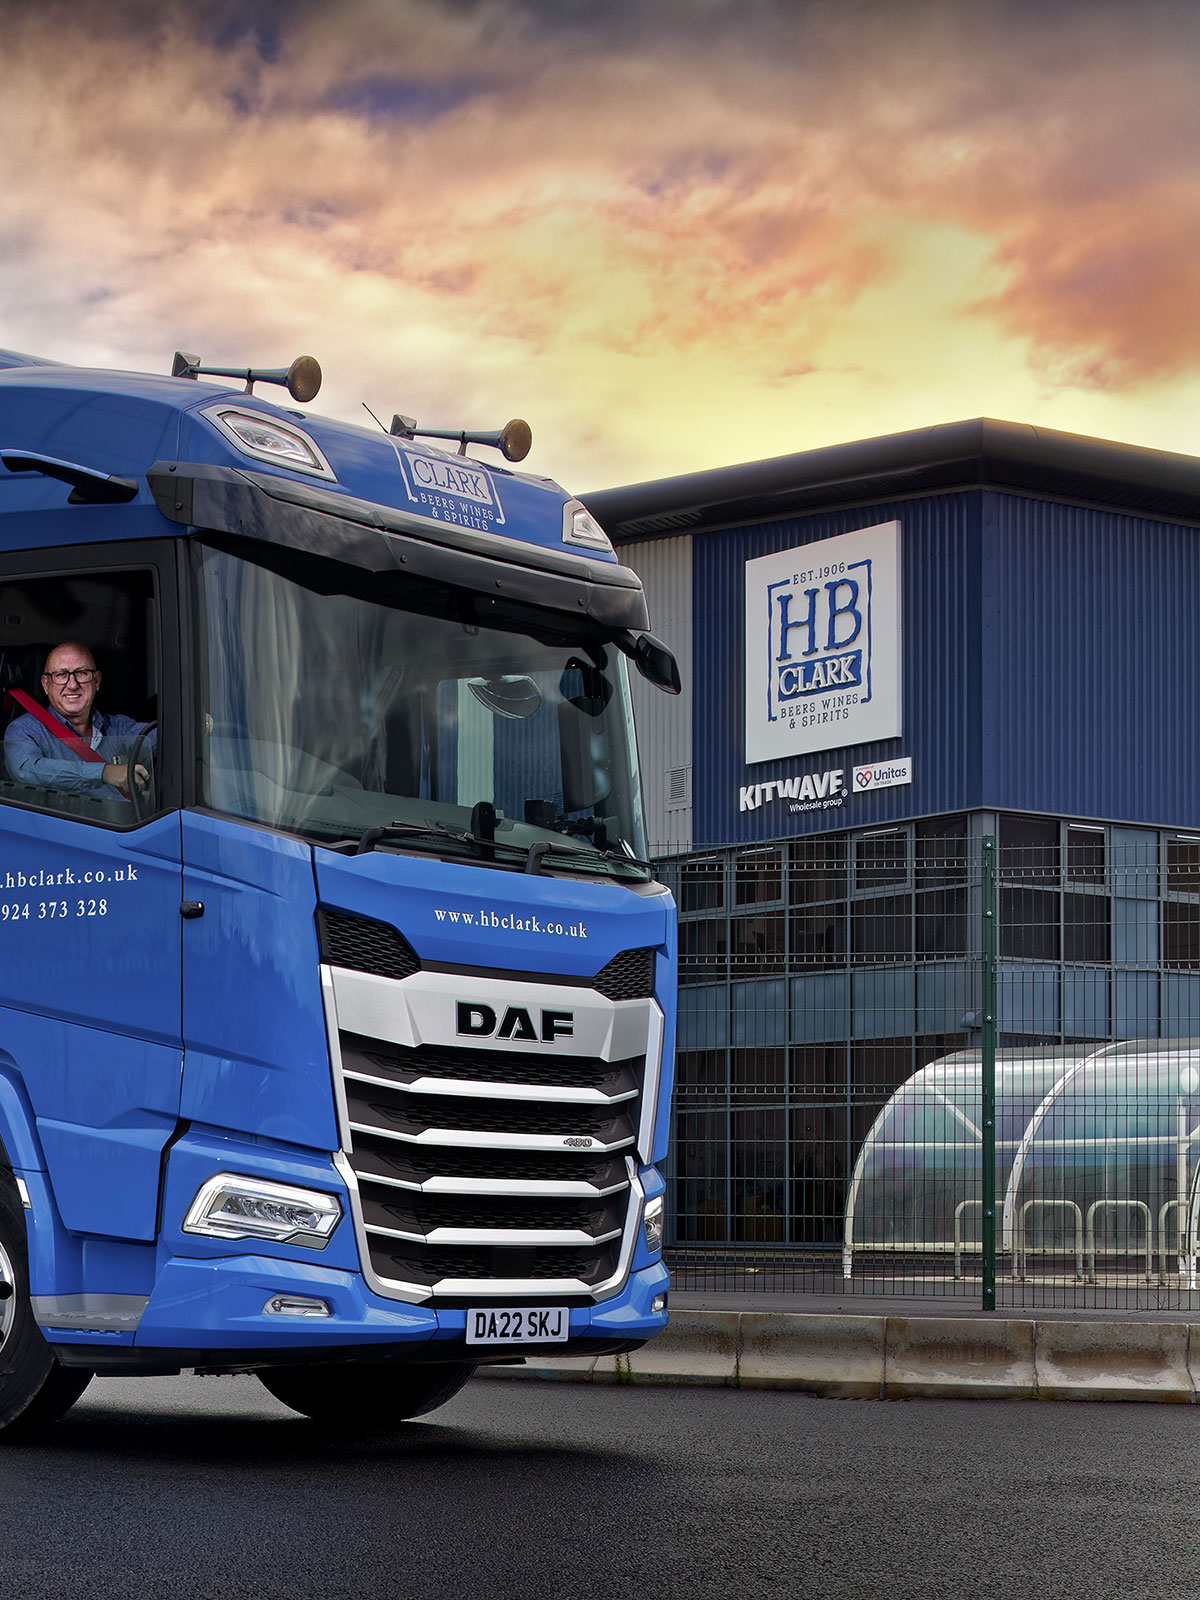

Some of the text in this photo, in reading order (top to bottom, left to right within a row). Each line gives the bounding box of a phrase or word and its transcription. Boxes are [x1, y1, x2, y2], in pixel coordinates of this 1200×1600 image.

[413, 459, 488, 500] CLARK
[419, 492, 494, 521] BEERS WINES
[431, 507, 489, 531] & SPIRITS
[776, 578, 862, 661] HB
[779, 655, 857, 696] CLARK
[780, 693, 859, 719] BEERS WINES
[788, 708, 850, 730] & SPIRITS
[873, 767, 907, 781] Unitas
[739, 769, 844, 812] KITWAVE
[789, 798, 843, 813] Wholesale group
[38, 901, 68, 919] 373
[76, 899, 108, 917] 328
[434, 909, 588, 938] www.hbclark.co.uk
[455, 999, 575, 1044] DAF
[474, 1311, 562, 1338] DA22 SKJ
